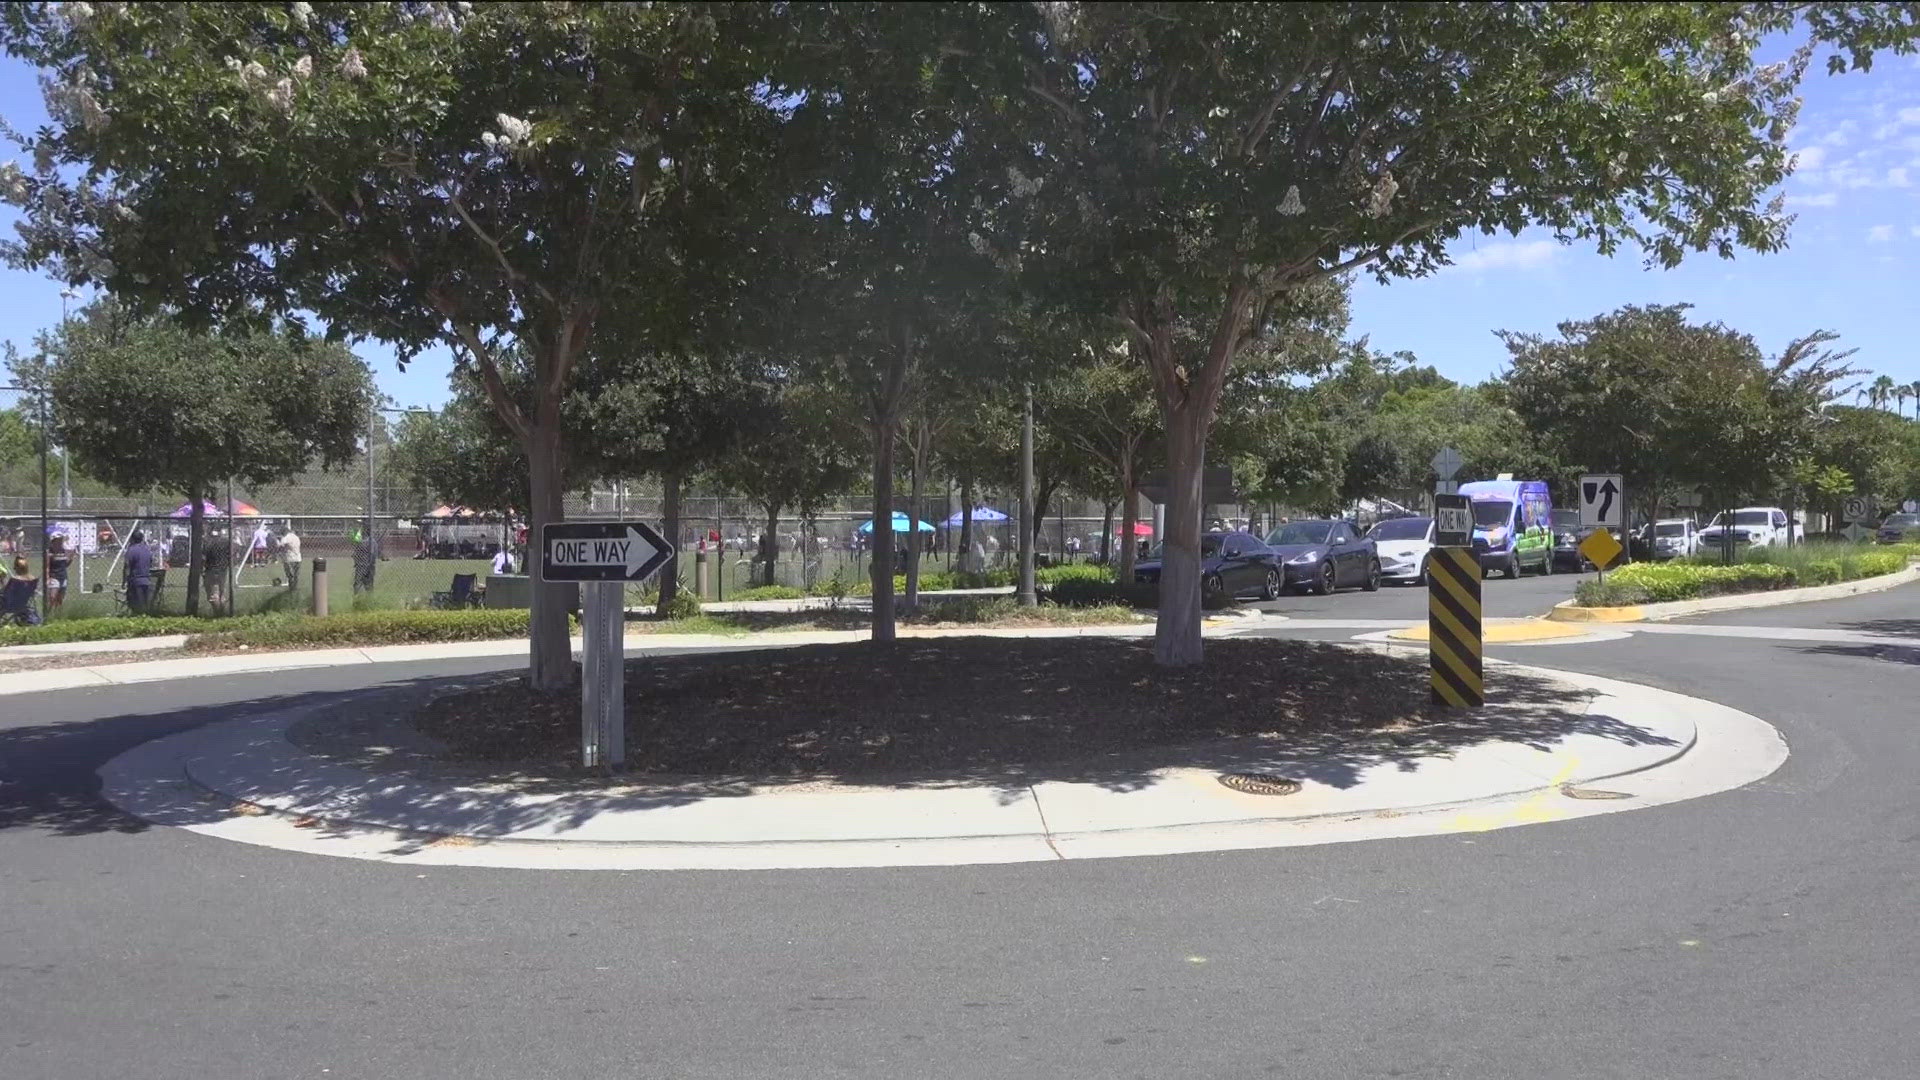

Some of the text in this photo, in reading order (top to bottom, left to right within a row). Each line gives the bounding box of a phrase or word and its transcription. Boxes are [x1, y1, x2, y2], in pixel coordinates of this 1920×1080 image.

[1440, 510, 1468, 530] ONE WAY
[555, 541, 631, 563] ONE WAY
